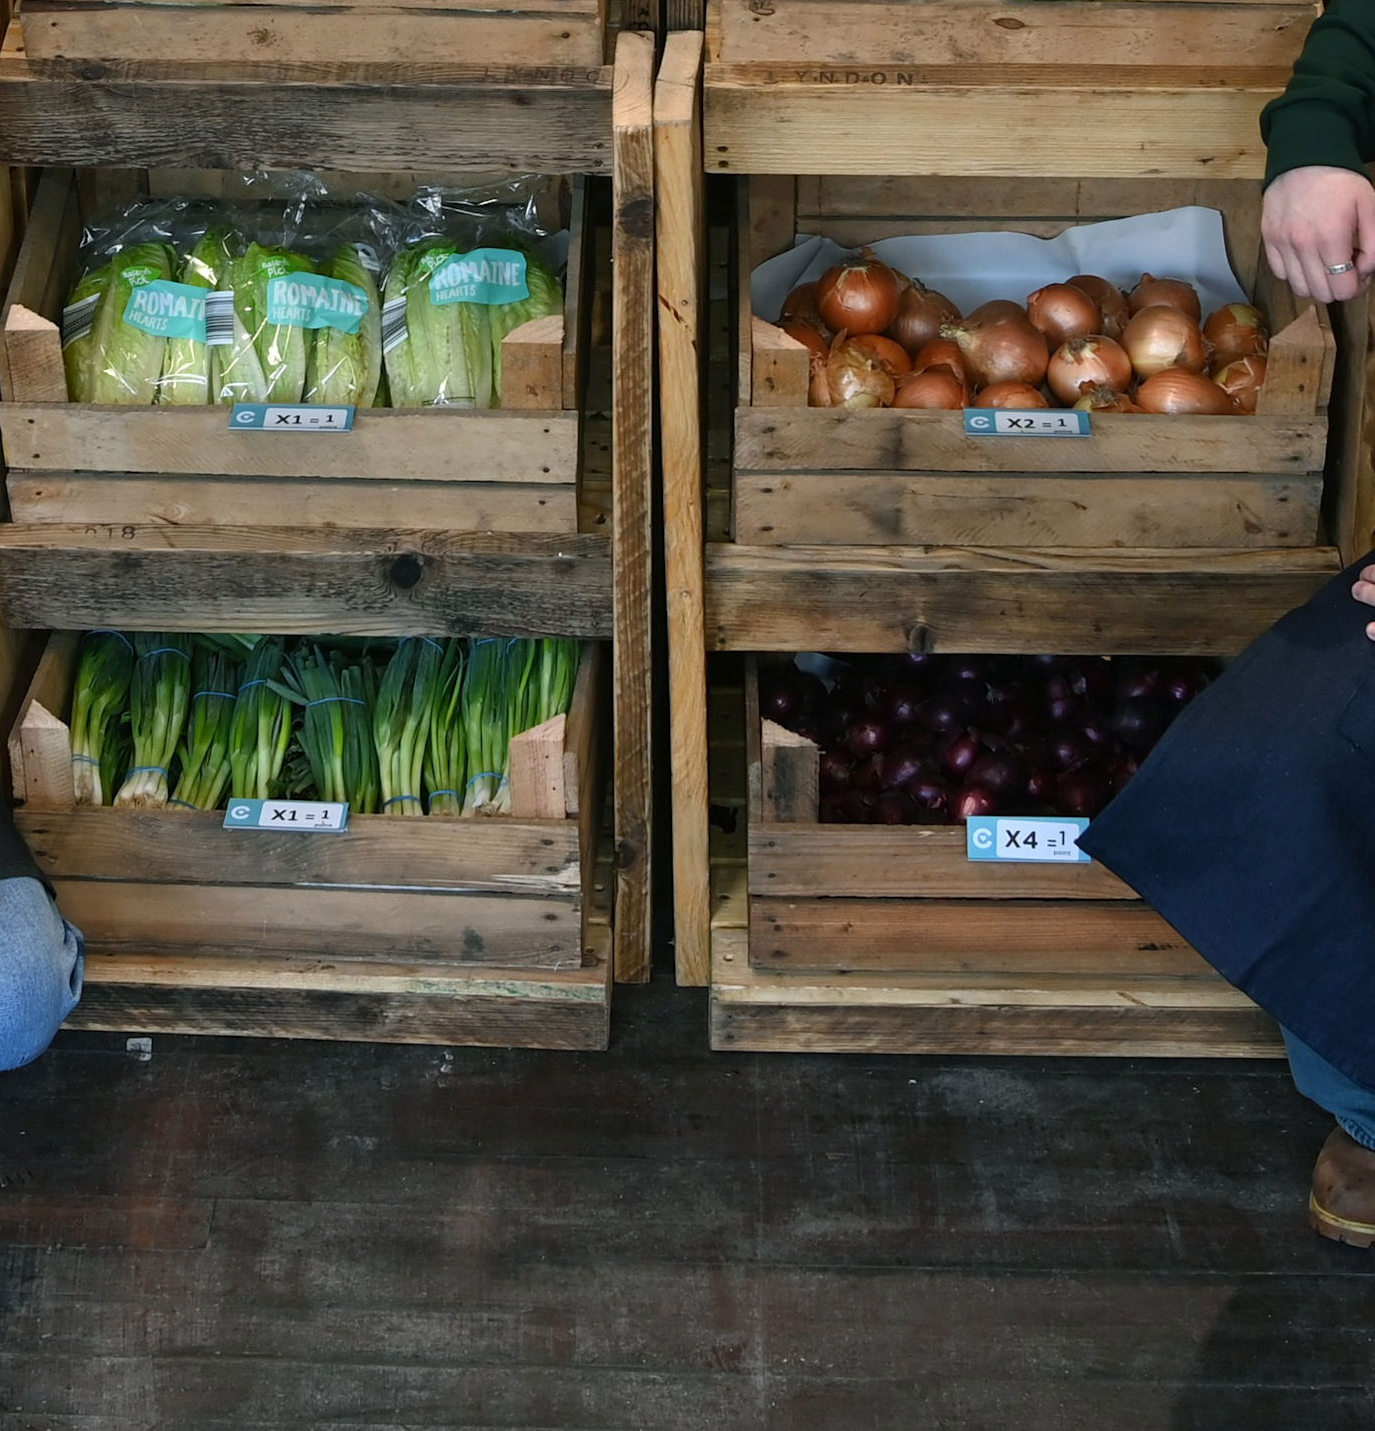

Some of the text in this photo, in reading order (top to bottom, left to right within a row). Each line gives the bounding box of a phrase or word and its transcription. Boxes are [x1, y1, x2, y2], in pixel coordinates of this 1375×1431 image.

[433, 259, 522, 290] ROMAINE
[273, 280, 369, 317] ROMAINE
[435, 284, 477, 302] HEARTS
[134, 289, 206, 321] ROMAI
[272, 306, 312, 322] HEARTS
[128, 309, 168, 332] HEARTS
[275, 414, 302, 425] X1
[325, 414, 334, 423] 1
[1007, 418, 1036, 429] X2
[1057, 418, 1067, 427] 1
[271, 809, 299, 822] X1
[320, 810, 330, 819] 1
[1005, 829, 1038, 849] X4
